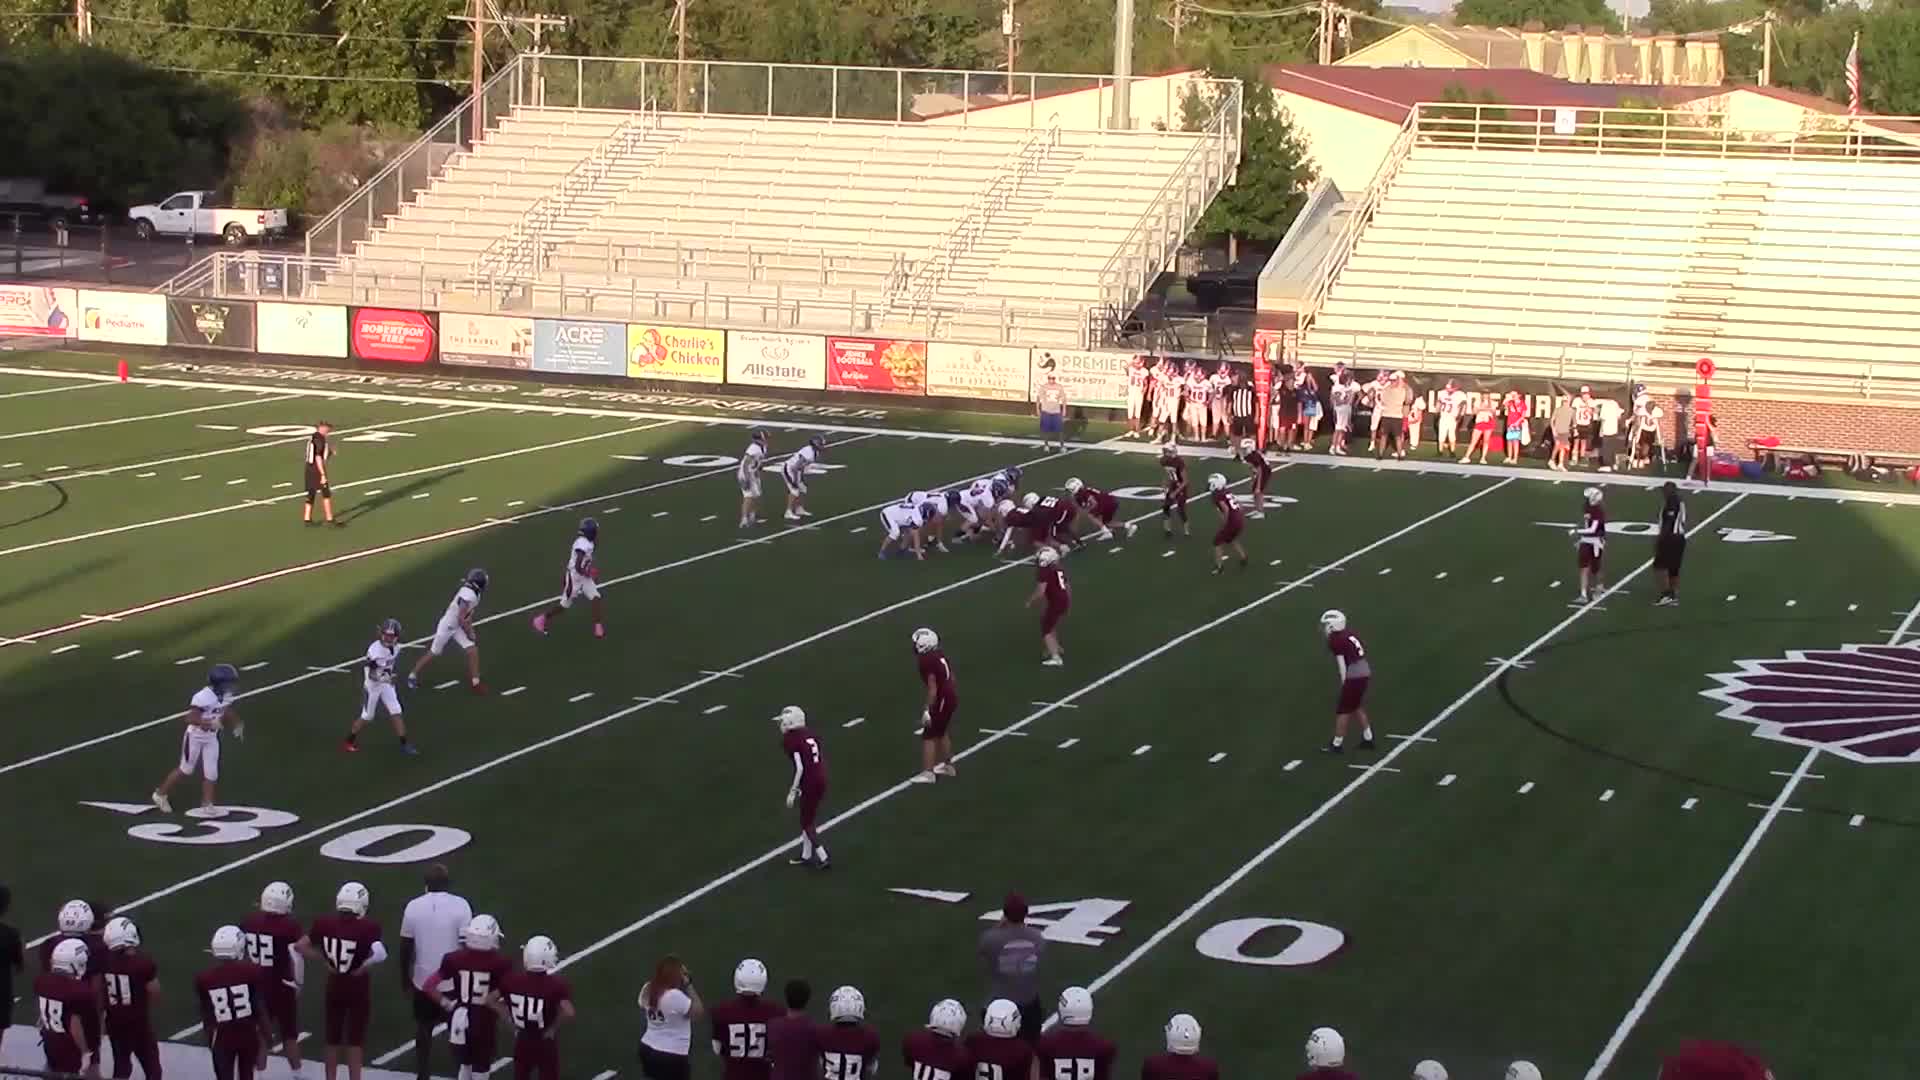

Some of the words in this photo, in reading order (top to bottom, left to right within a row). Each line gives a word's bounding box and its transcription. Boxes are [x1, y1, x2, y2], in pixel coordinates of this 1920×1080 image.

[361, 323, 424, 337] ROBERTSON
[381, 334, 405, 344] TIRE
[555, 326, 604, 344] ACRE
[665, 335, 714, 350] Charlie's
[671, 351, 720, 366] Chicken
[1062, 356, 1129, 371] PREMIER
[742, 363, 806, 379] Allstate
[246, 932, 274, 967] 22
[323, 935, 357, 974] 45
[458, 969, 491, 1005] 15
[208, 983, 253, 1023] 83
[509, 993, 545, 1029] 24
[728, 1022, 767, 1058] 55
